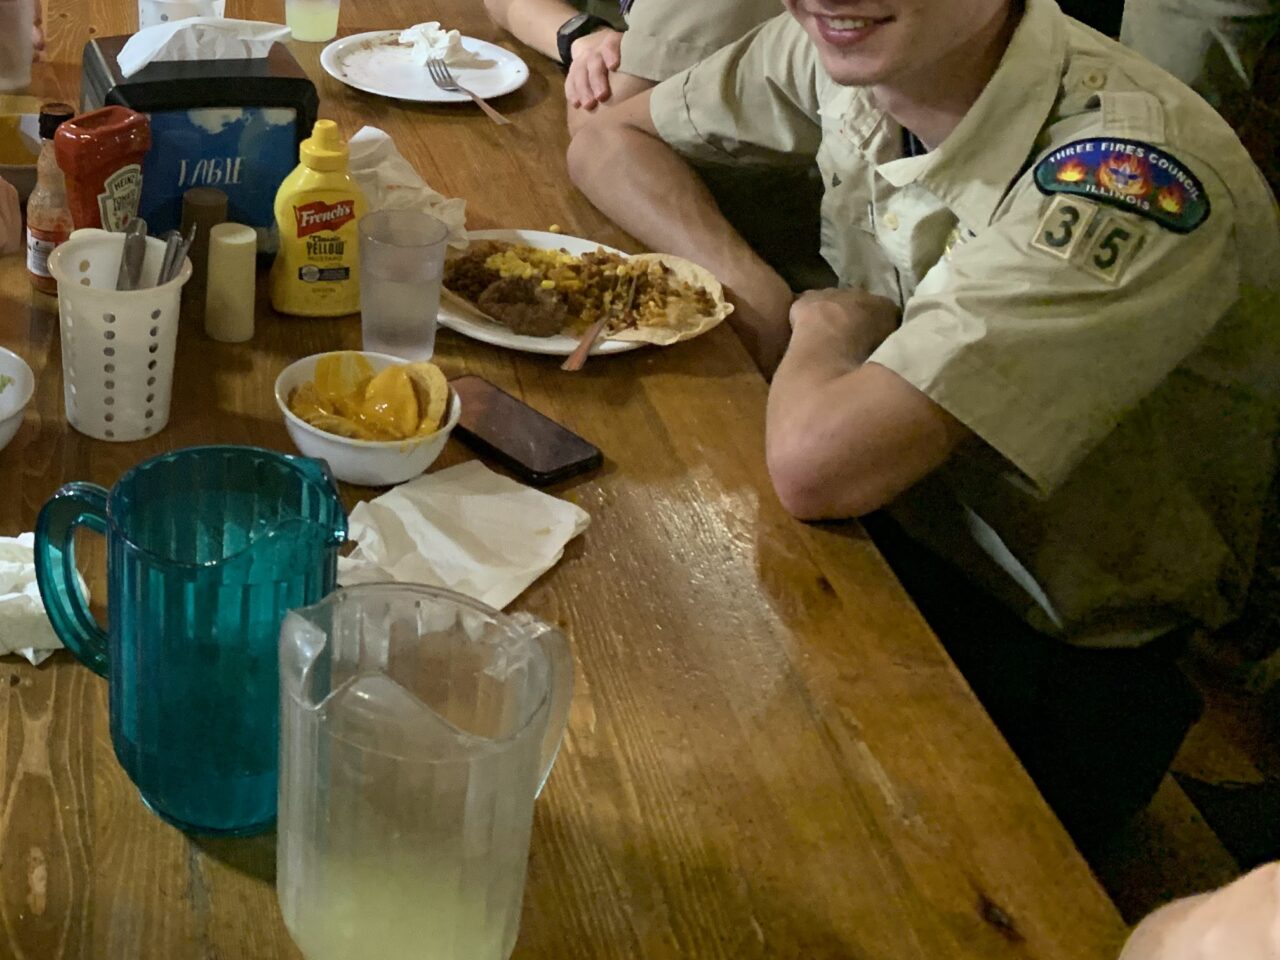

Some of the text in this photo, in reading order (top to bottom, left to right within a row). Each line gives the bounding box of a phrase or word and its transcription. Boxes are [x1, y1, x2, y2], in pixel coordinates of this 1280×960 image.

[1049, 141, 1200, 202] THREE FIRES COUNCIL
[1085, 184, 1151, 211] ILLINOIS
[300, 203, 351, 227] French's
[306, 241, 345, 256] YELLOW
